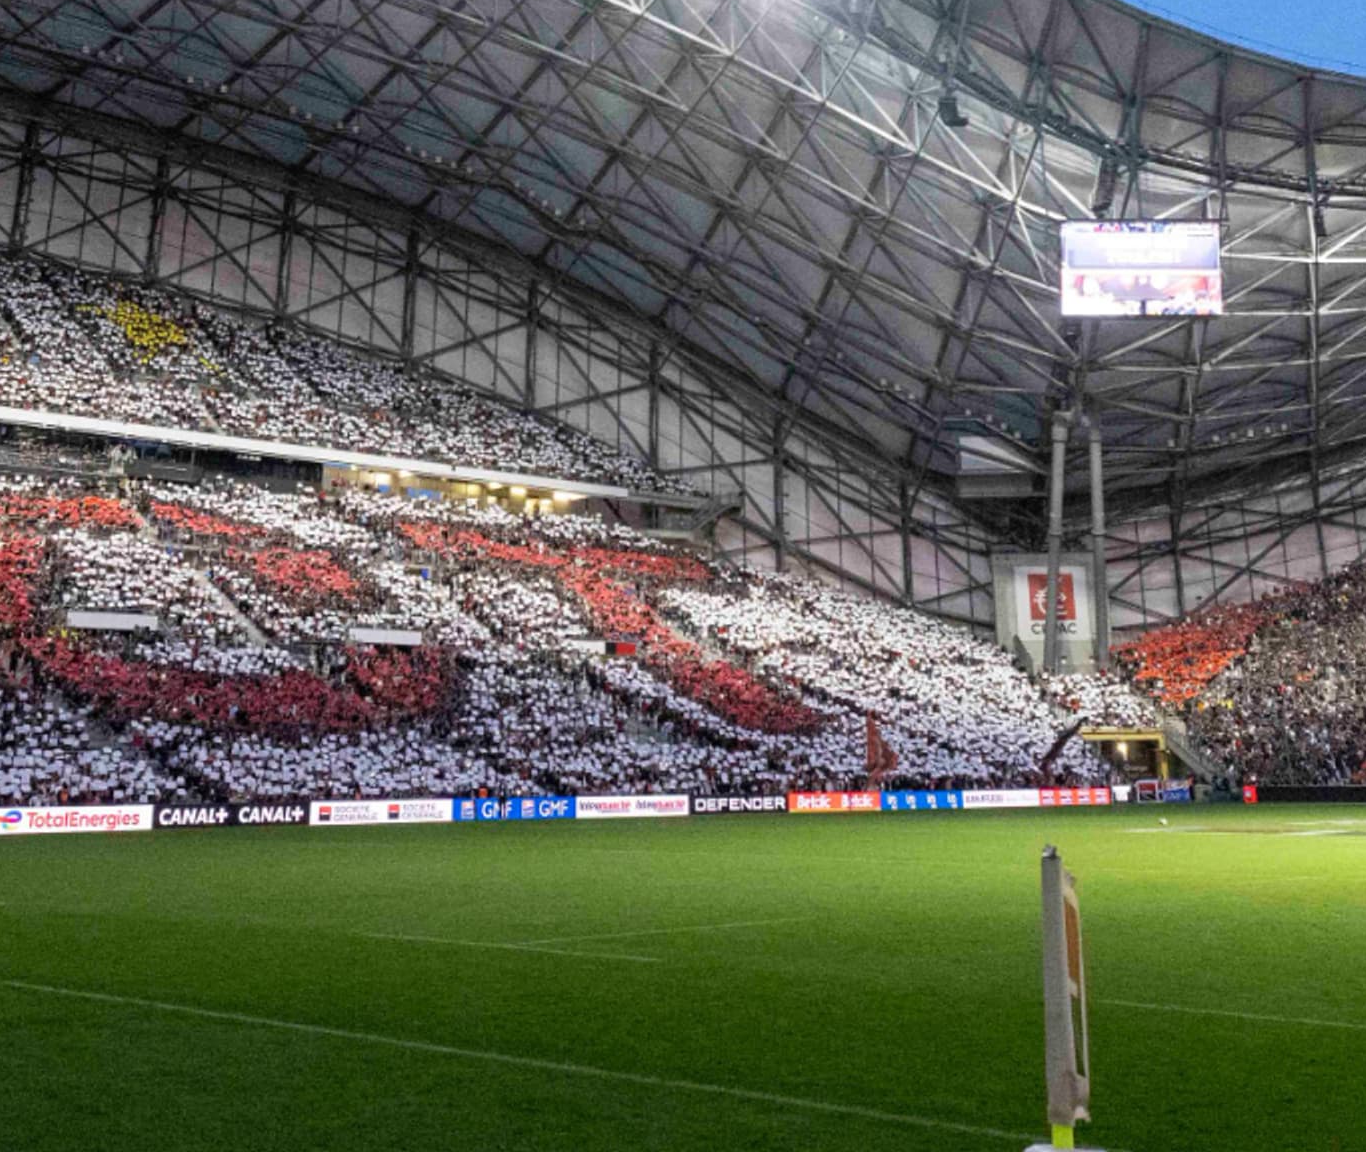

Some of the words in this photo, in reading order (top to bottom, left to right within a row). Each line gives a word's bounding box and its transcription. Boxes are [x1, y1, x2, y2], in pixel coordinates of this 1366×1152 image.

[539, 800, 569, 817] GMF
[694, 796, 785, 811] DEFENDER
[26, 810, 140, 830] TotalEnergies
[158, 807, 229, 825] CANAL+
[238, 805, 304, 823] CANAL+
